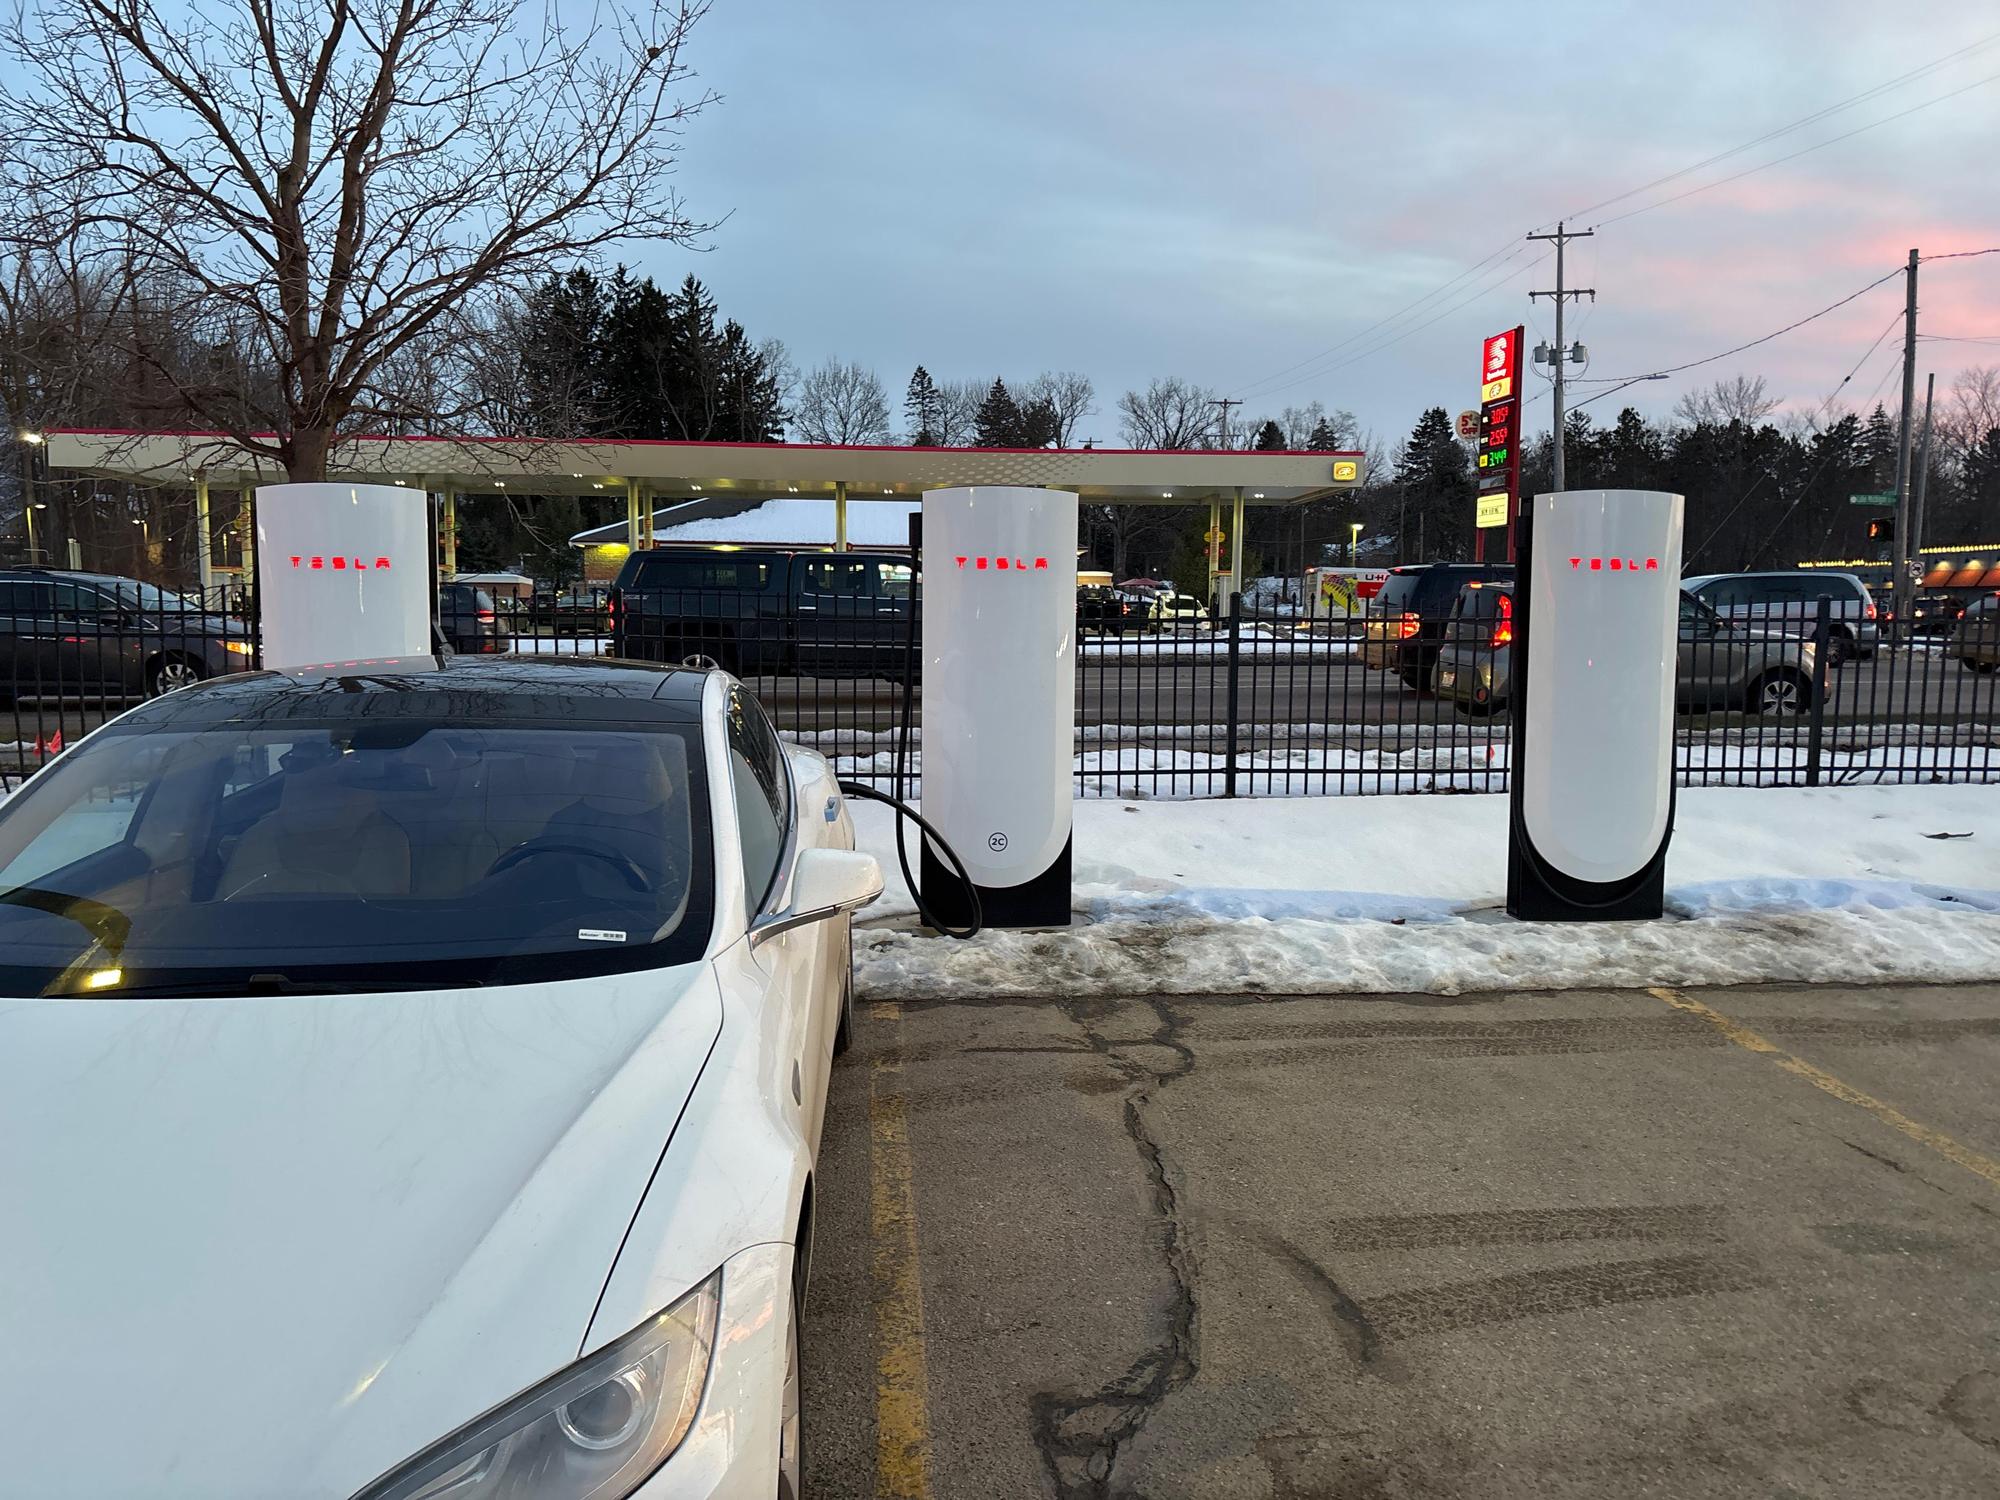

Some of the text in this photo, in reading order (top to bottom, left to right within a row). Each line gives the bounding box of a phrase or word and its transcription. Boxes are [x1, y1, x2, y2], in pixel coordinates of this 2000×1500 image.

[1461, 426, 1478, 435] OFF
[290, 556, 391, 570] TESLA
[955, 556, 1048, 571] TESLA
[1569, 557, 1658, 571] TESLA
[991, 837, 1005, 846] 2C
